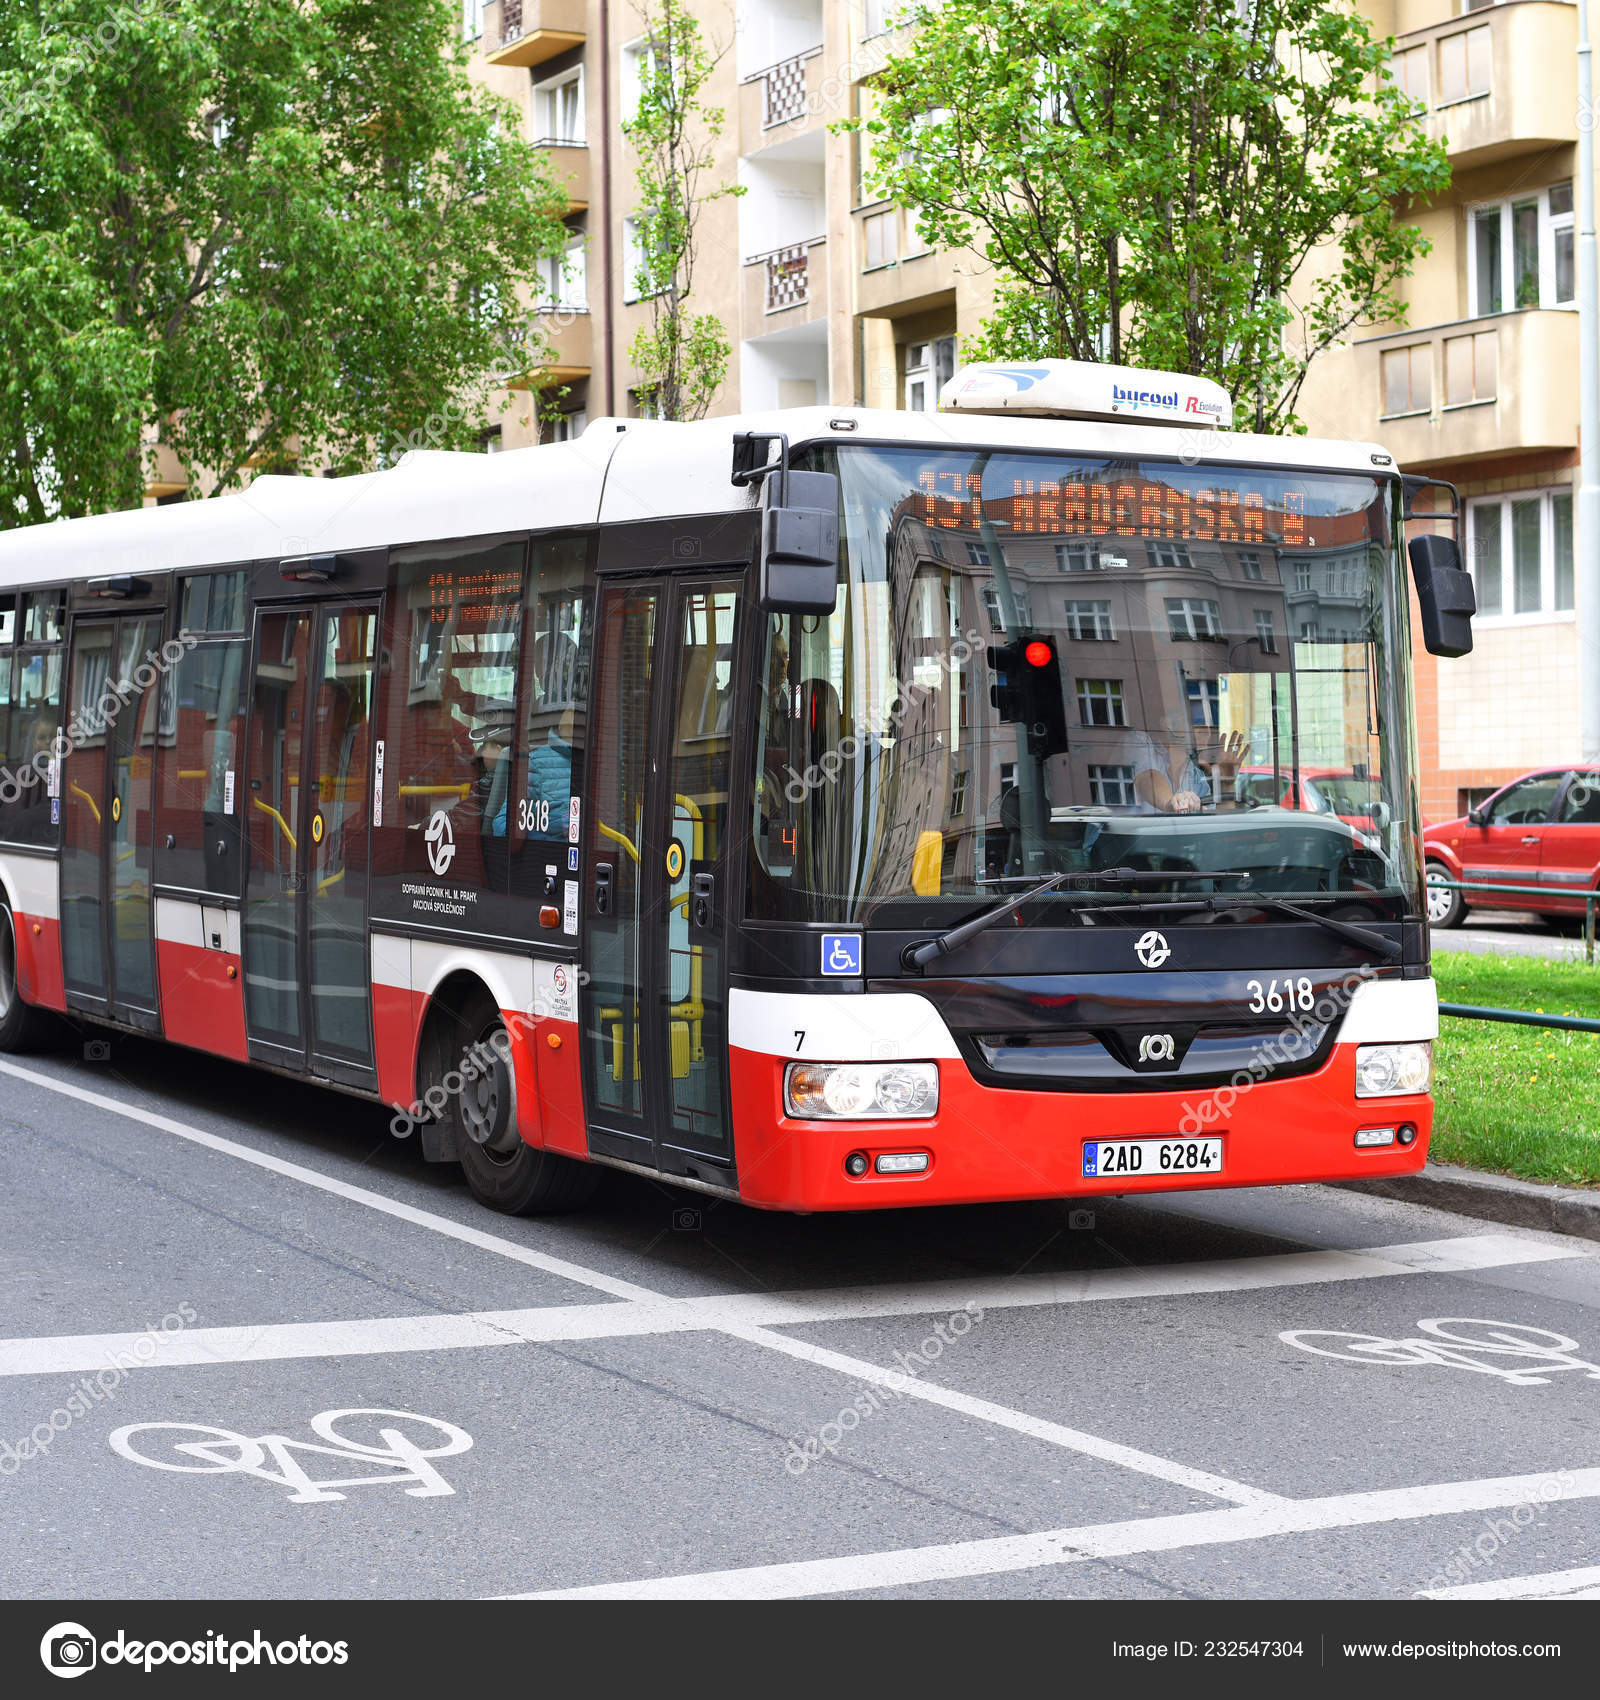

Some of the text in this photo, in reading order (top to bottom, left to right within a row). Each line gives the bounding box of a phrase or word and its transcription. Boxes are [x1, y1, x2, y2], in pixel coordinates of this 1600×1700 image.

[919, 471, 982, 528] 131
[518, 798, 550, 833] 3618
[402, 882, 426, 896] DOPRAVNÍ
[426, 885, 445, 898] PODNIK
[412, 898, 466, 916] AKCIOVÁ SPOLEČNOST
[1246, 977, 1315, 1014] 3618
[793, 1030, 807, 1052] 7
[1085, 1142, 1212, 1174] CZ 2AD 6284
